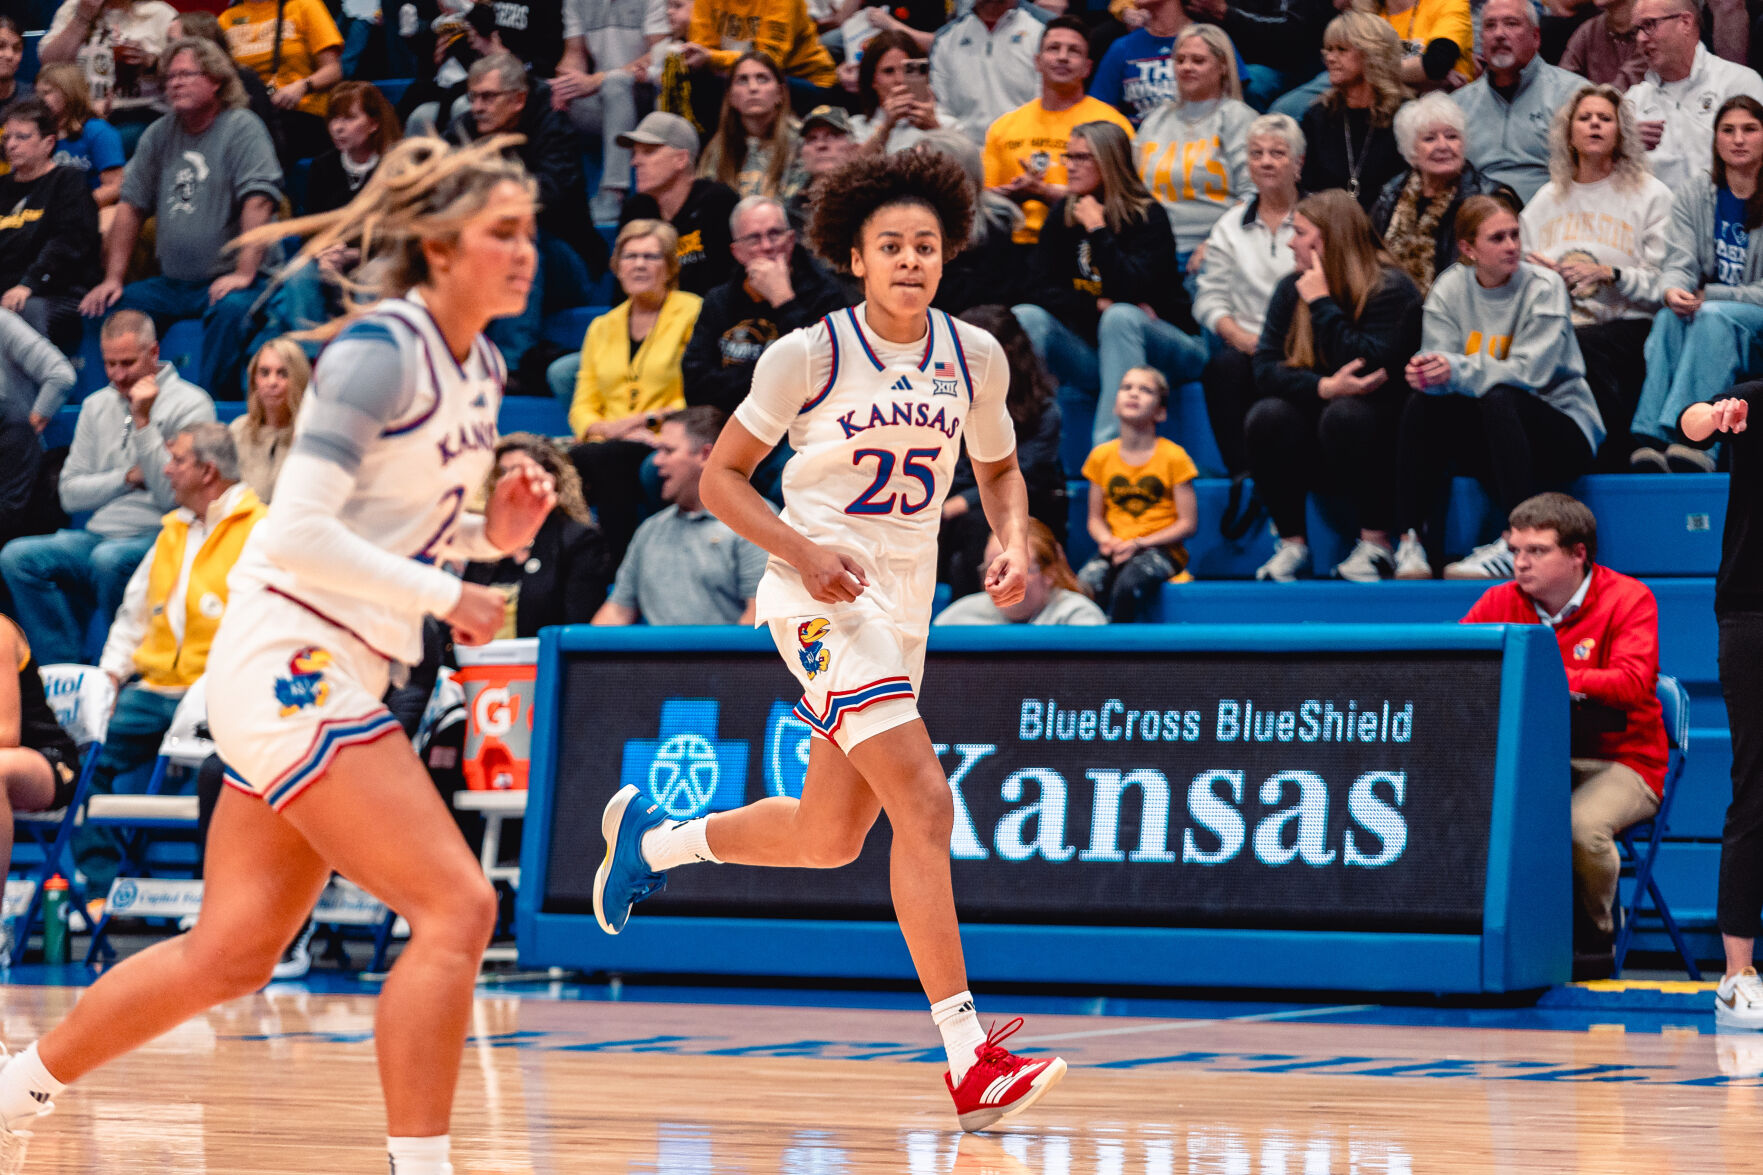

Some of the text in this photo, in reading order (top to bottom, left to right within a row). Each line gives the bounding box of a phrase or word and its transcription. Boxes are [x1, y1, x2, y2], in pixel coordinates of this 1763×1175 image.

[836, 401, 960, 440] KANSAS
[843, 446, 942, 516] 25
[476, 687, 512, 736] G
[1019, 697, 1413, 744] BlueCross BlueShield
[933, 743, 1409, 868] Kansas
